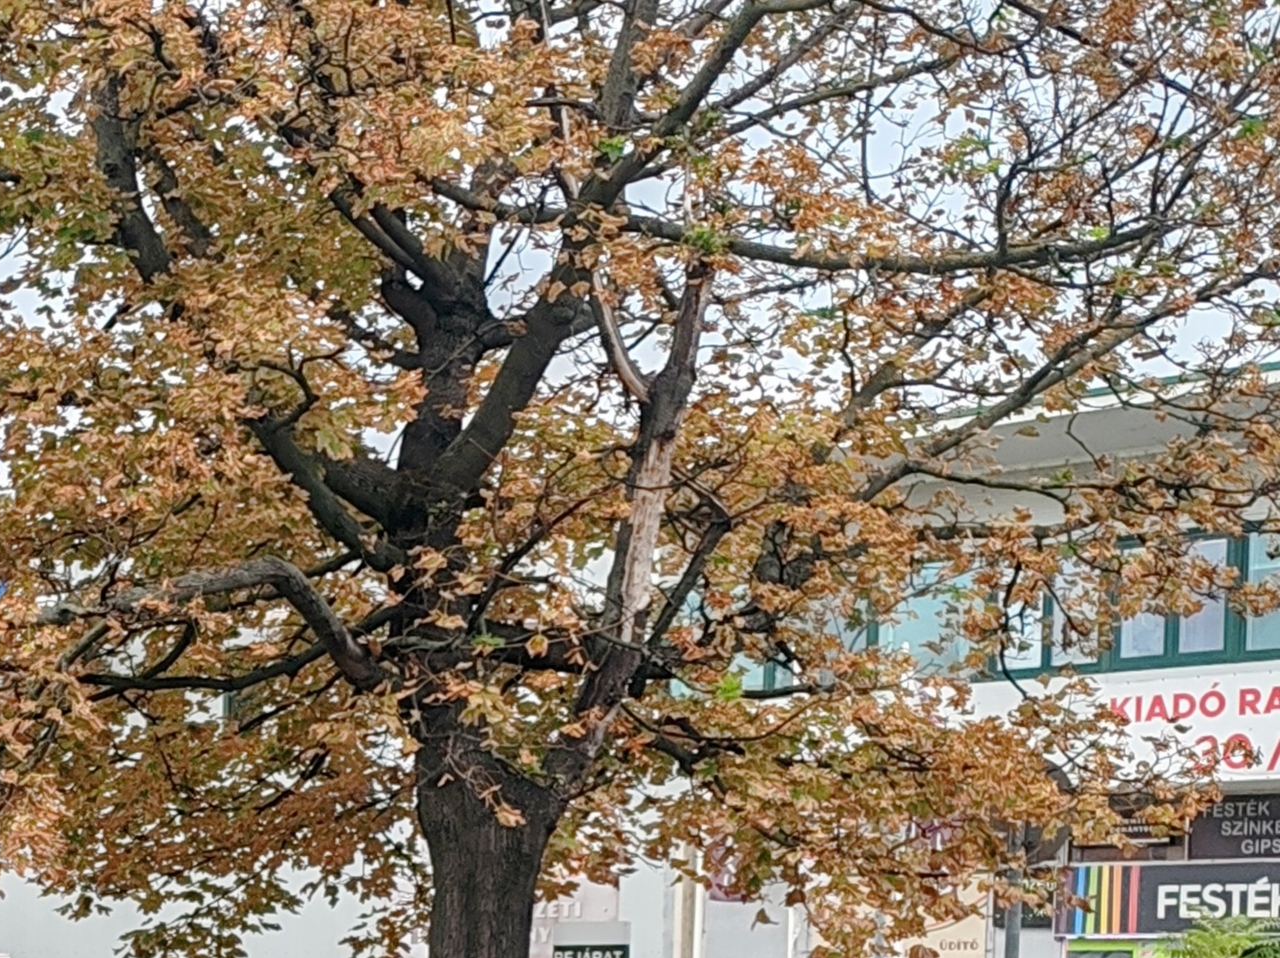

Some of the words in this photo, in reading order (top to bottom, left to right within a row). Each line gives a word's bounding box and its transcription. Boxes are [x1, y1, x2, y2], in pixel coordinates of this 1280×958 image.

[1110, 682, 1226, 724] KIADÓ
[1203, 799, 1270, 818] FESTÉK
[1241, 839, 1280, 855] GIPS
